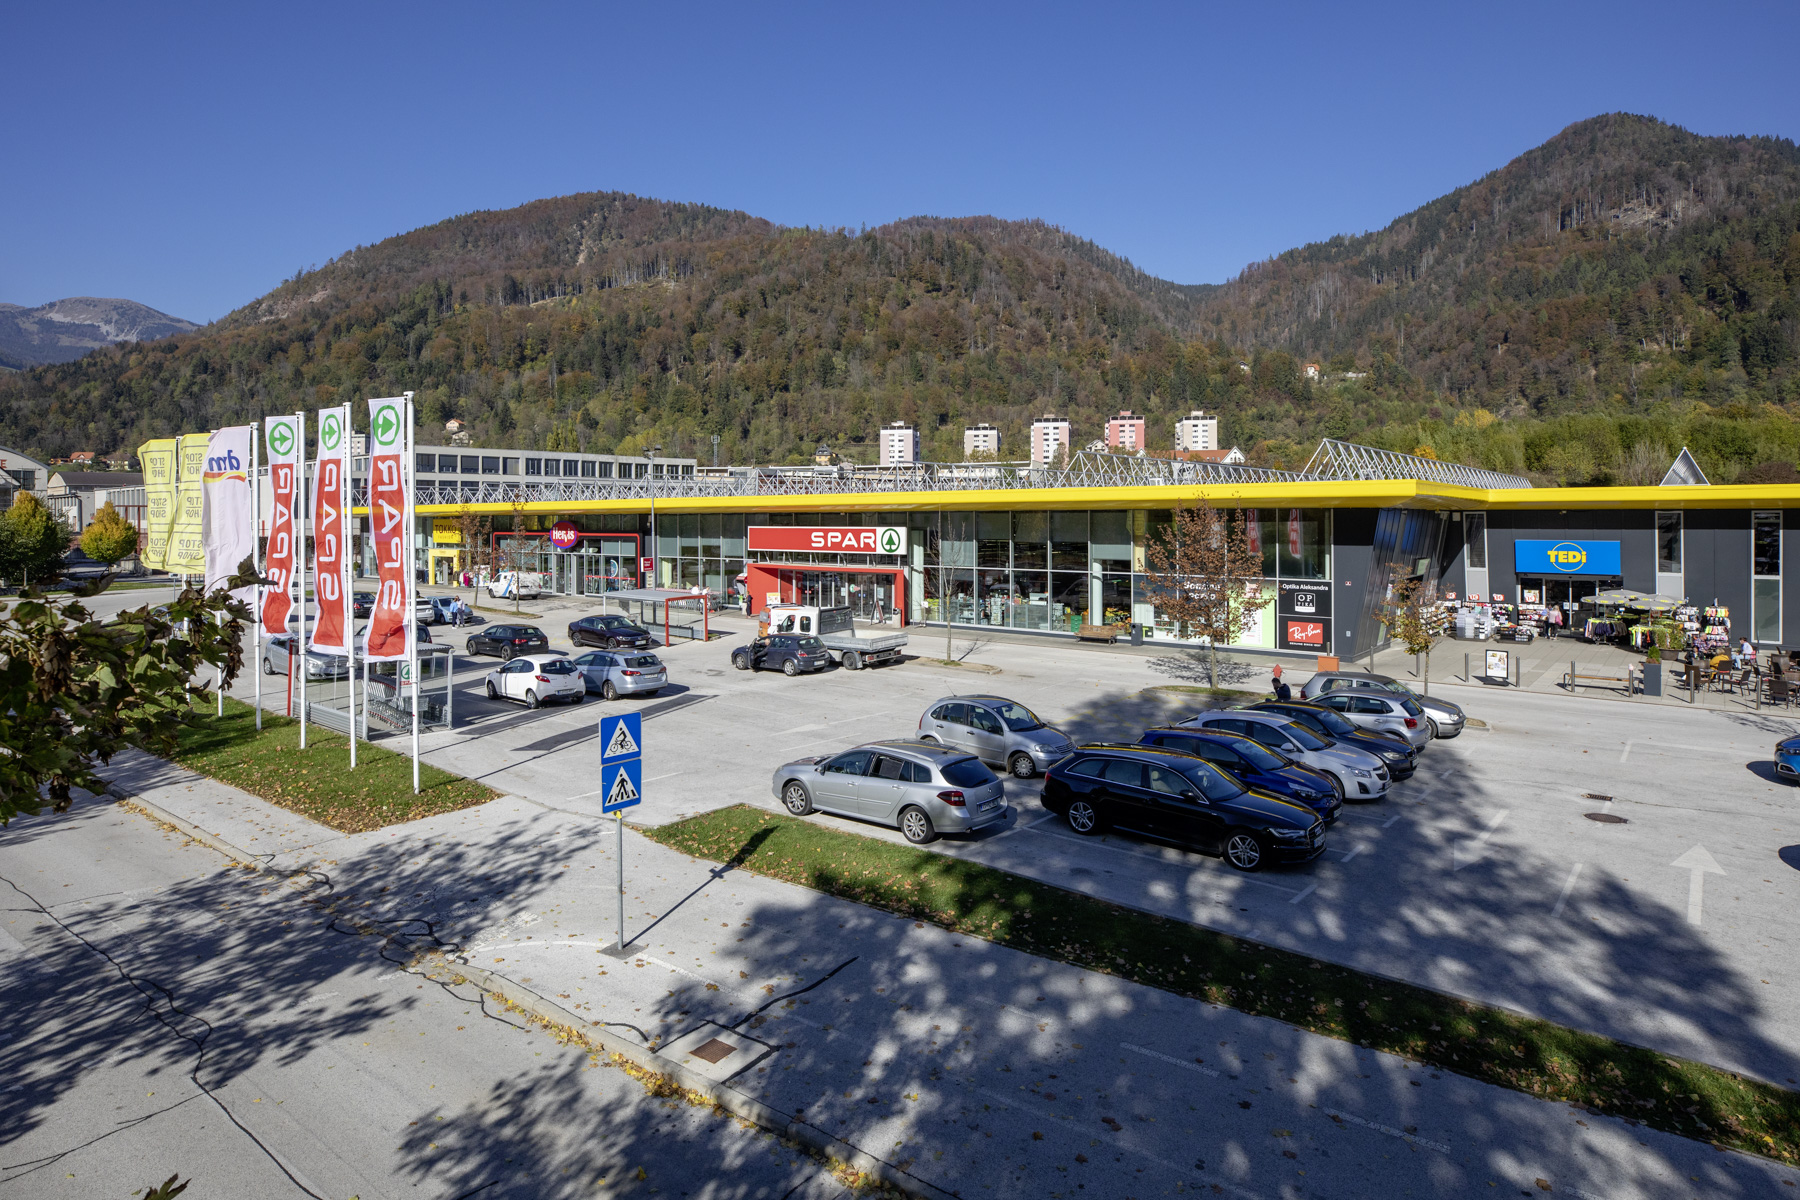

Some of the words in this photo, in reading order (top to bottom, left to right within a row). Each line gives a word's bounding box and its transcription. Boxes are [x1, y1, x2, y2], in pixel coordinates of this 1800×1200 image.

[434, 524, 457, 534] TOKKO
[552, 526, 575, 543] Hervis
[810, 531, 876, 549] SPAR
[1547, 550, 1587, 563] TEDi
[1289, 624, 1322, 640] Ray-Ban
